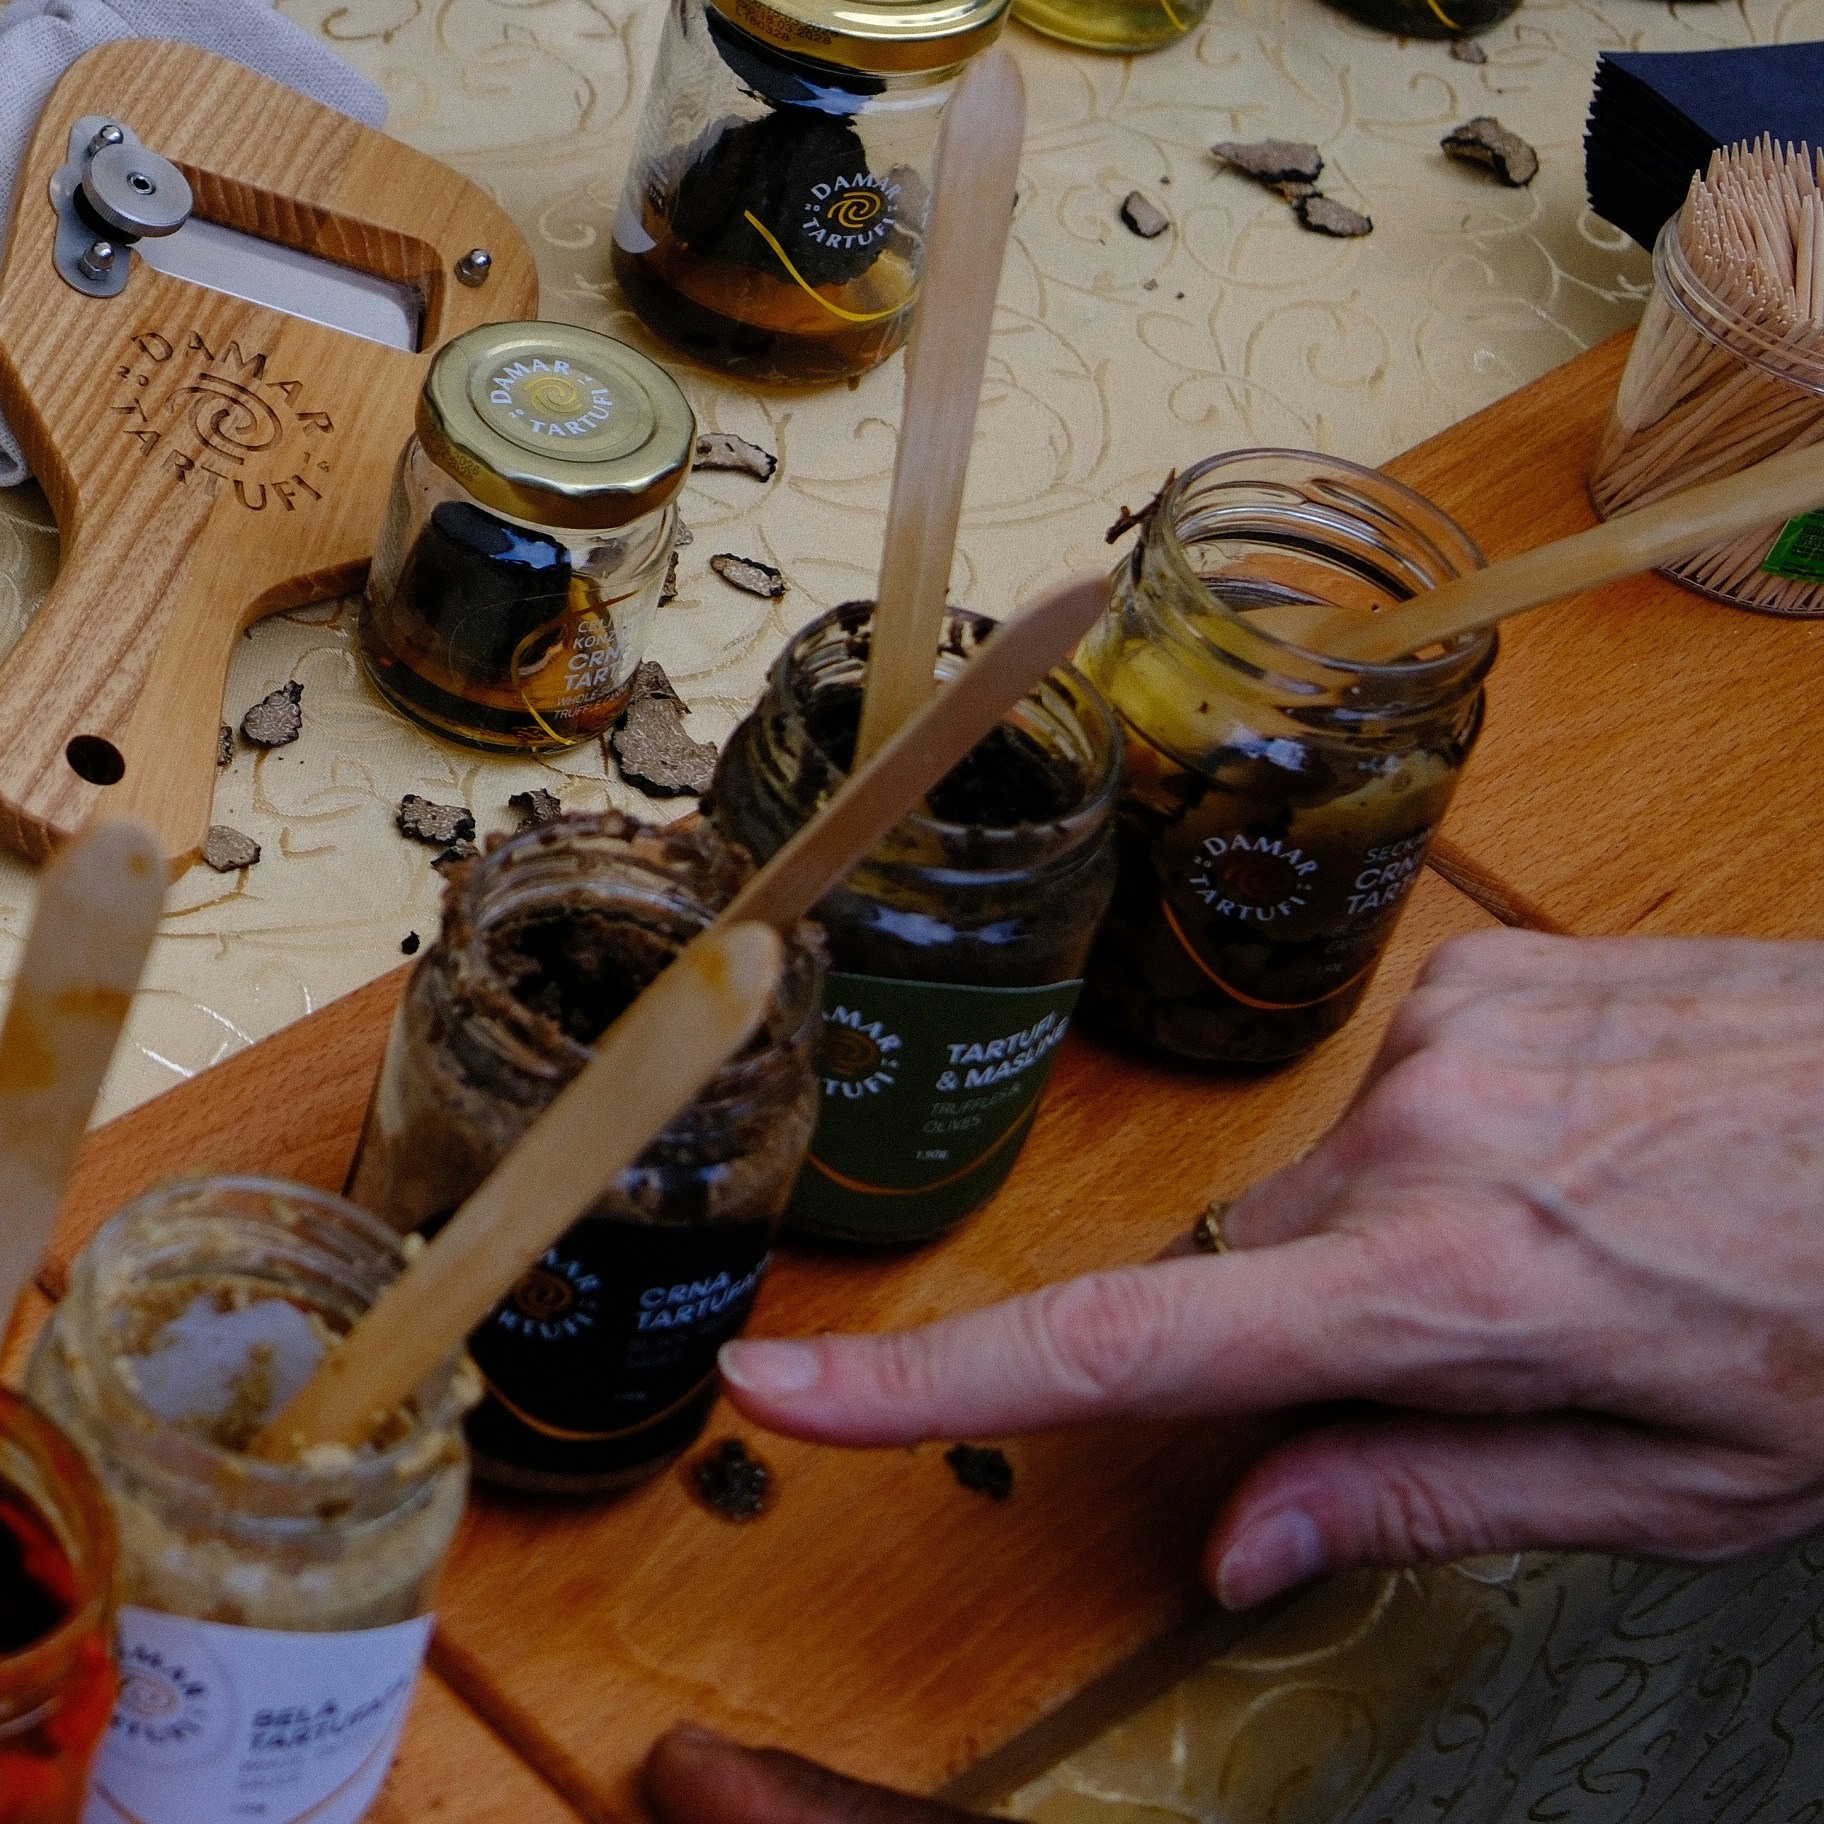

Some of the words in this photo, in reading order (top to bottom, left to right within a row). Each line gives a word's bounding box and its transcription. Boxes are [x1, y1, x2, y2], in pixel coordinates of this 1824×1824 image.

[810, 171, 902, 202] DAMAR
[801, 215, 895, 250] TARTUFI
[129, 330, 336, 437] DAMAR
[490, 357, 572, 407] DAMAR
[530, 386, 614, 438] TARTUFI
[122, 396, 324, 514] TARTUFI
[1203, 833, 1320, 877] DAMAR
[1189, 872, 1308, 922] TARTUFI
[946, 1010, 1059, 1066] TARTUFI
[935, 1070, 960, 1093] &
[638, 1269, 733, 1311] CRNA
